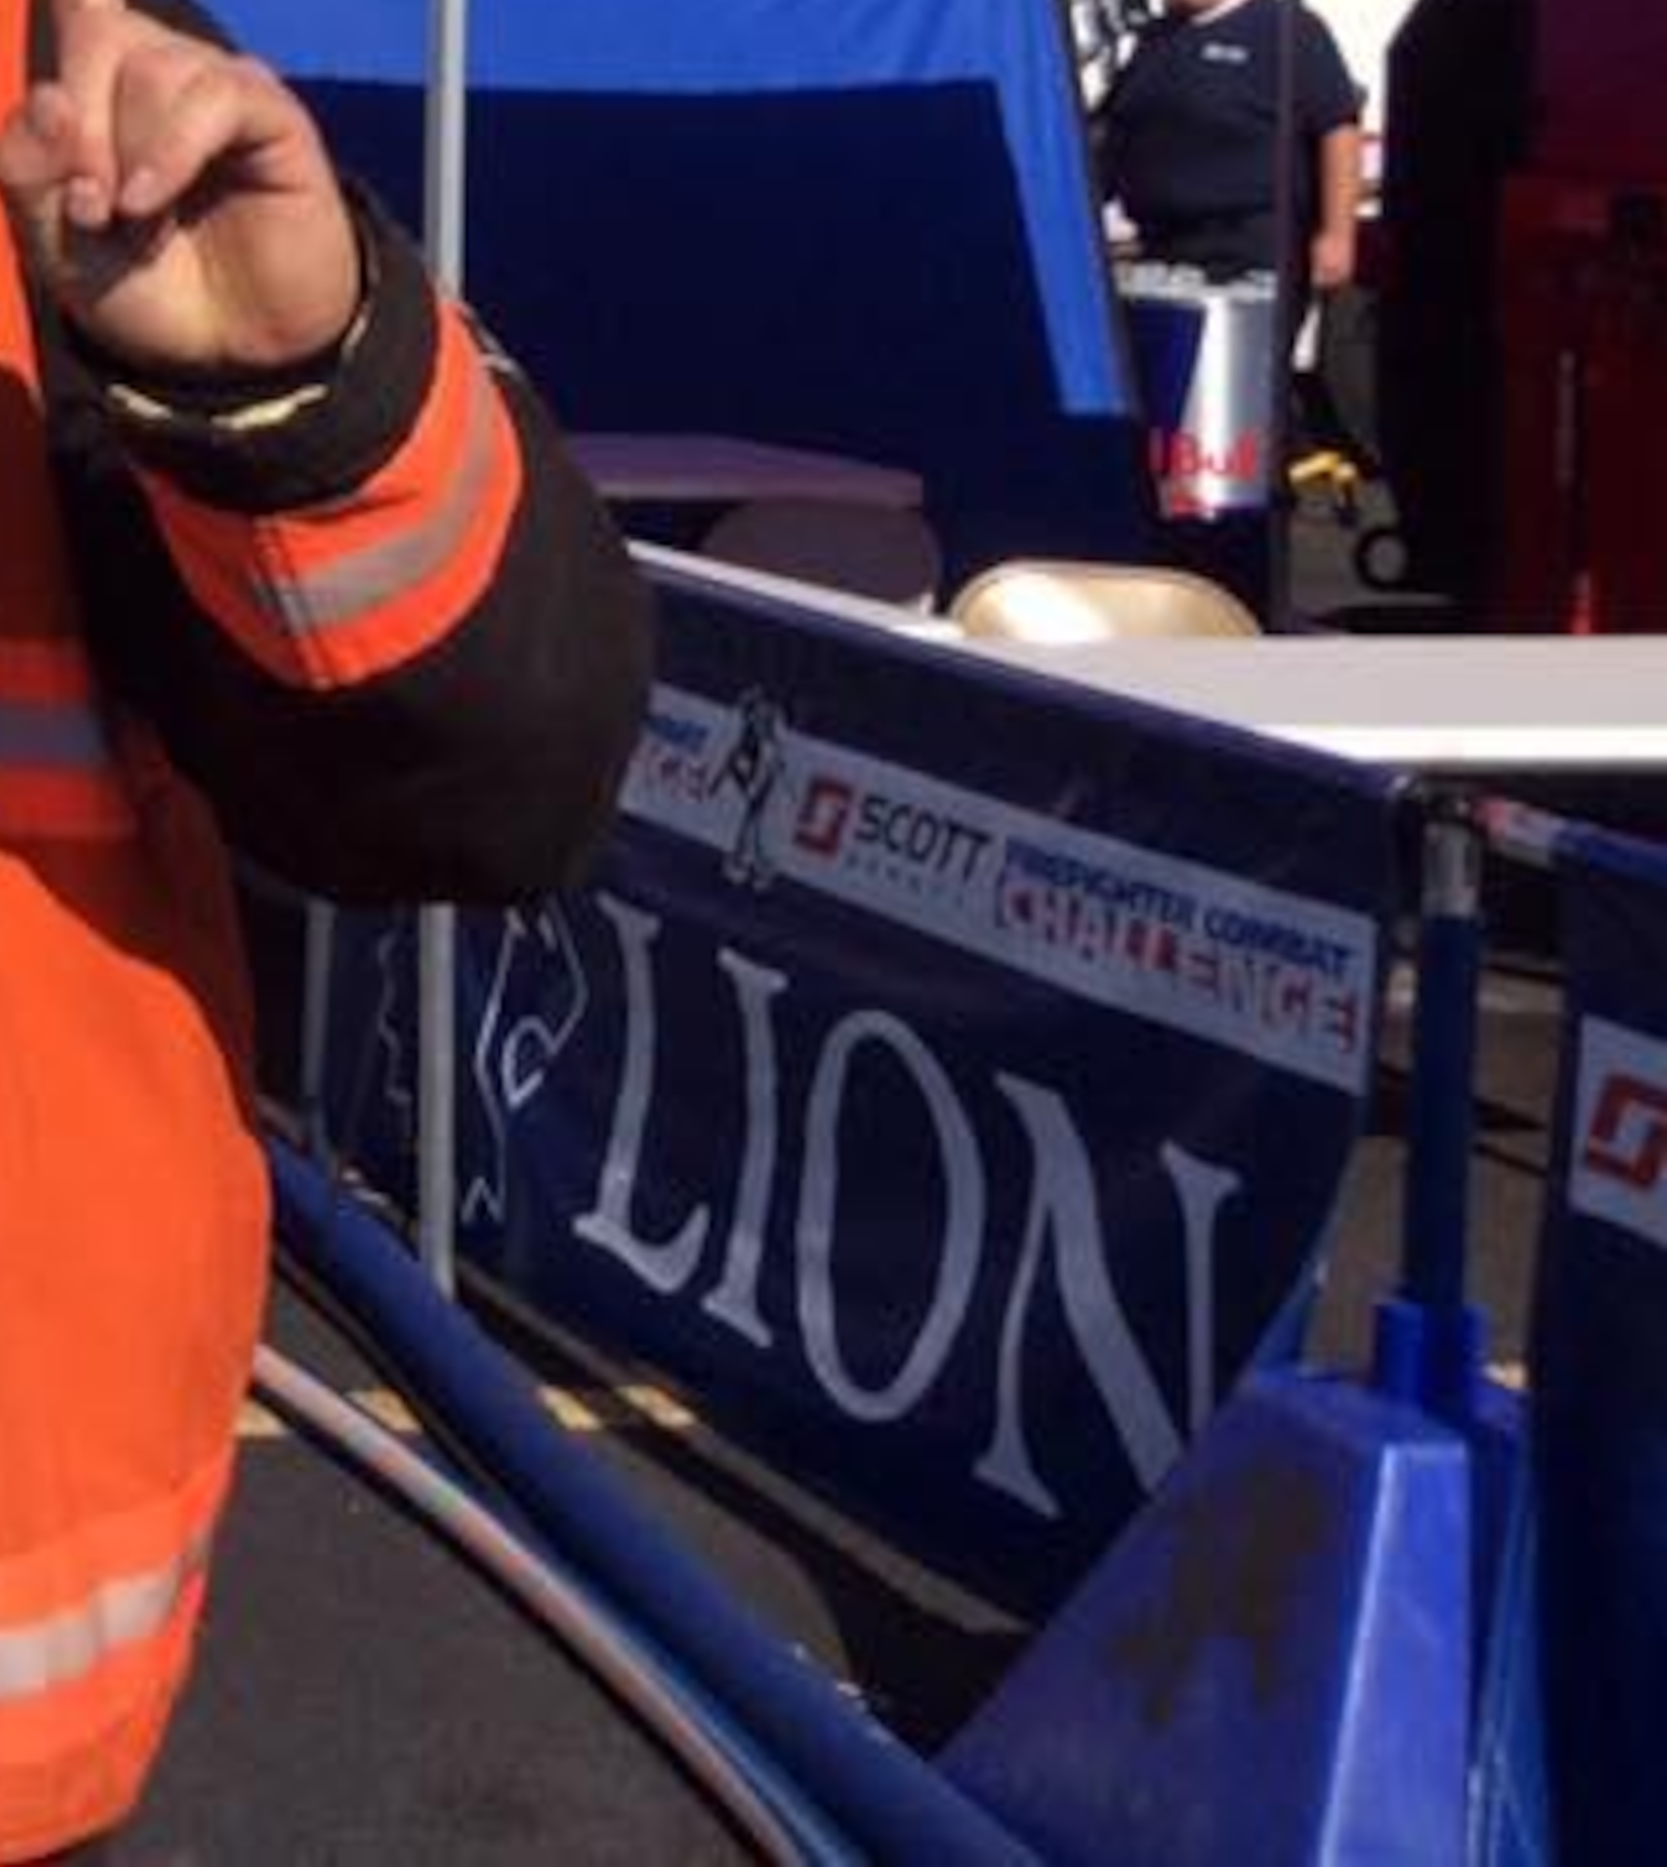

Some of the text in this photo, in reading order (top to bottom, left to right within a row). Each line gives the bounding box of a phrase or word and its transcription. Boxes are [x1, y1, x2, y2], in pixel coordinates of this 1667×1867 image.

[853, 794, 993, 882] SCOTT
[1000, 879, 1359, 1054] CHALLENGE
[573, 890, 1245, 1520] LION
